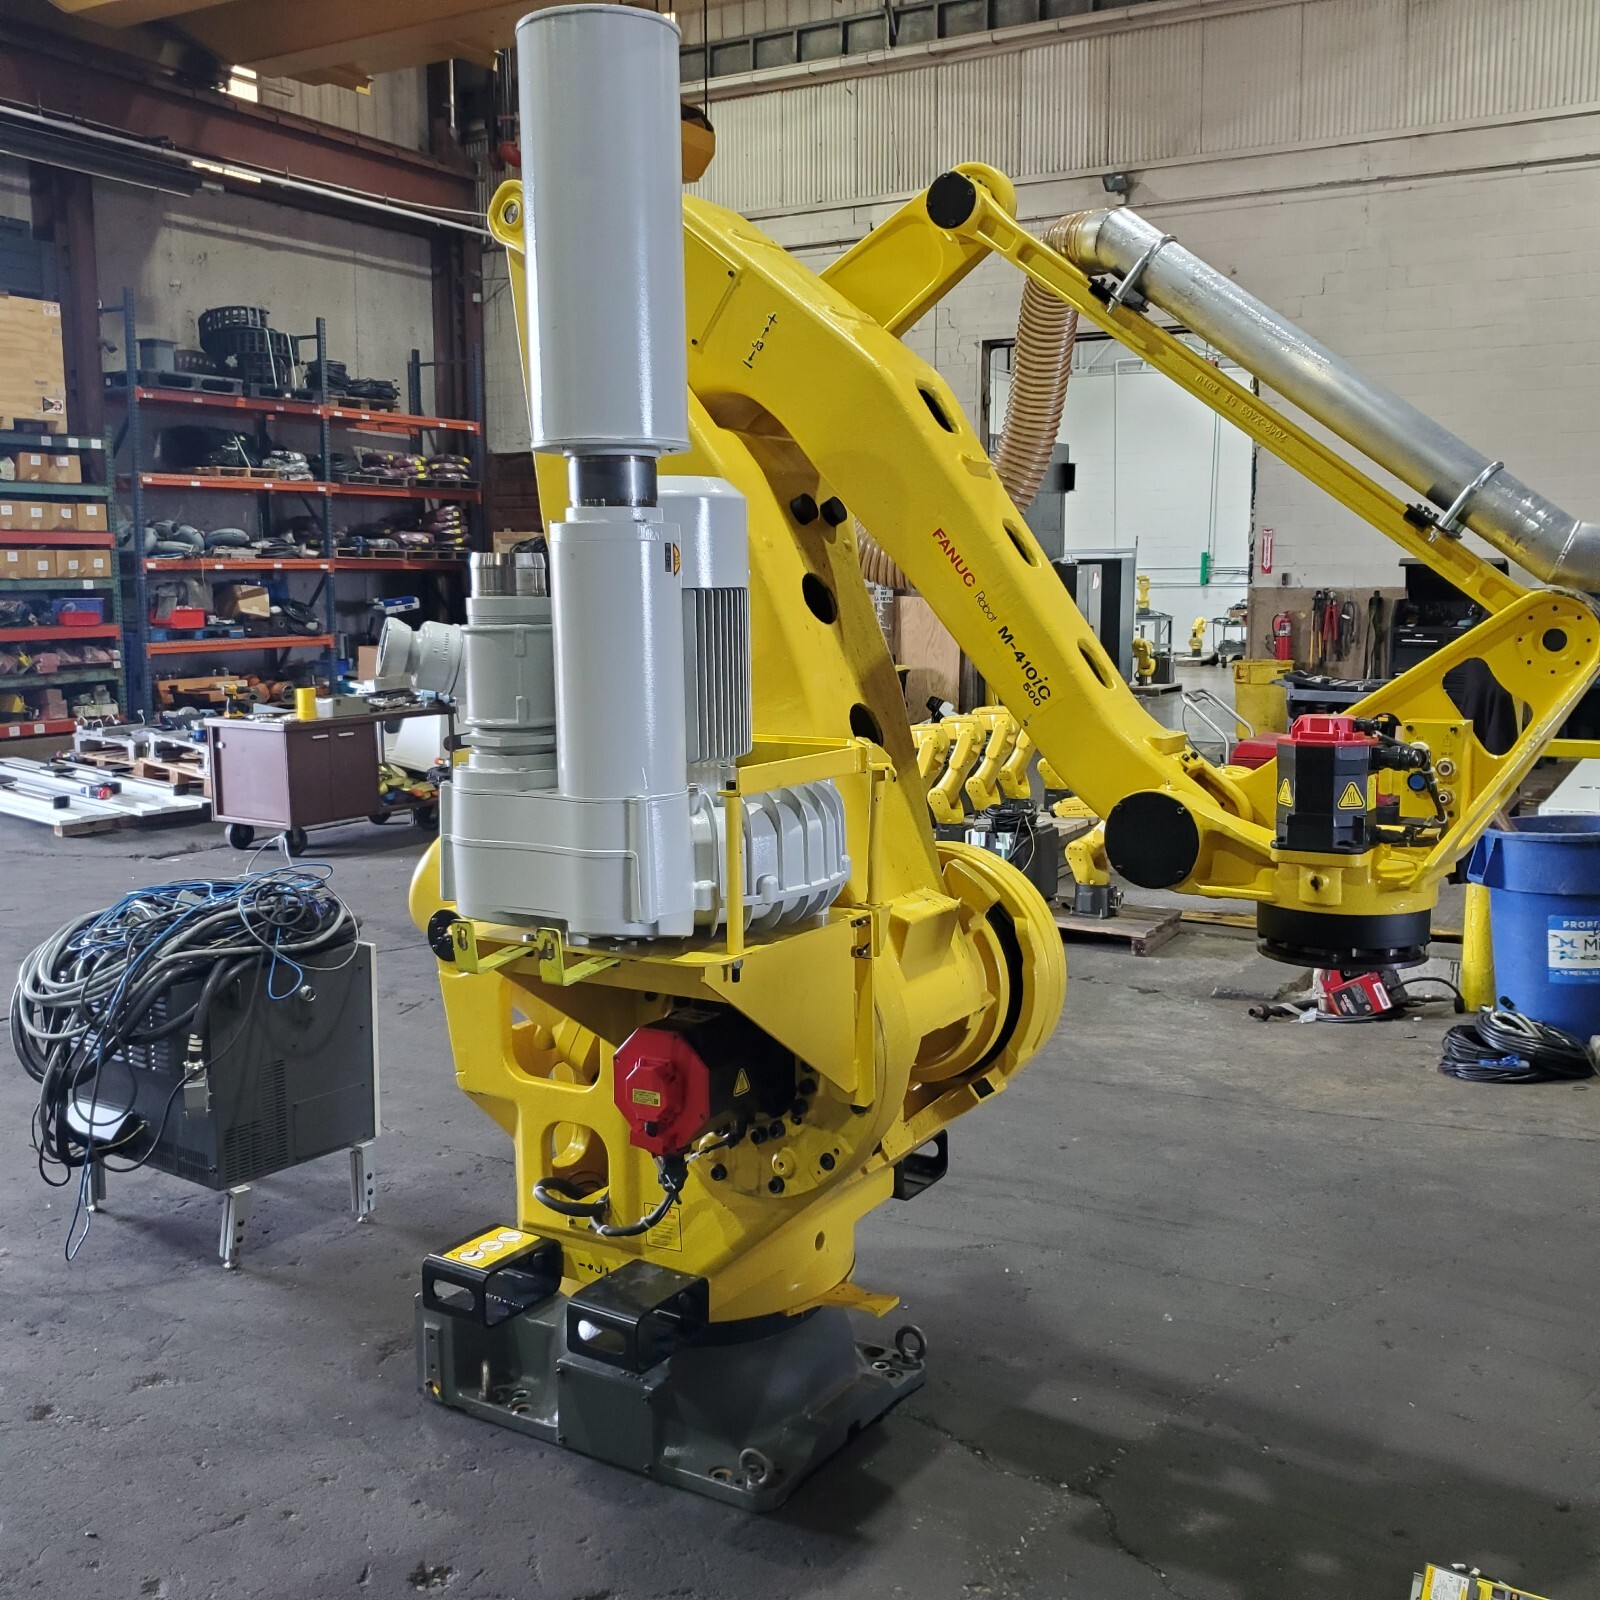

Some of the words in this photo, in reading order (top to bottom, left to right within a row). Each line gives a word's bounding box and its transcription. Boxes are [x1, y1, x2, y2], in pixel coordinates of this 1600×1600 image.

[751, 340, 764, 352] J3
[932, 527, 976, 588] FANUC
[974, 590, 998, 623] Robot
[997, 625, 1051, 700] M-410iC
[1022, 682, 1041, 707] 500
